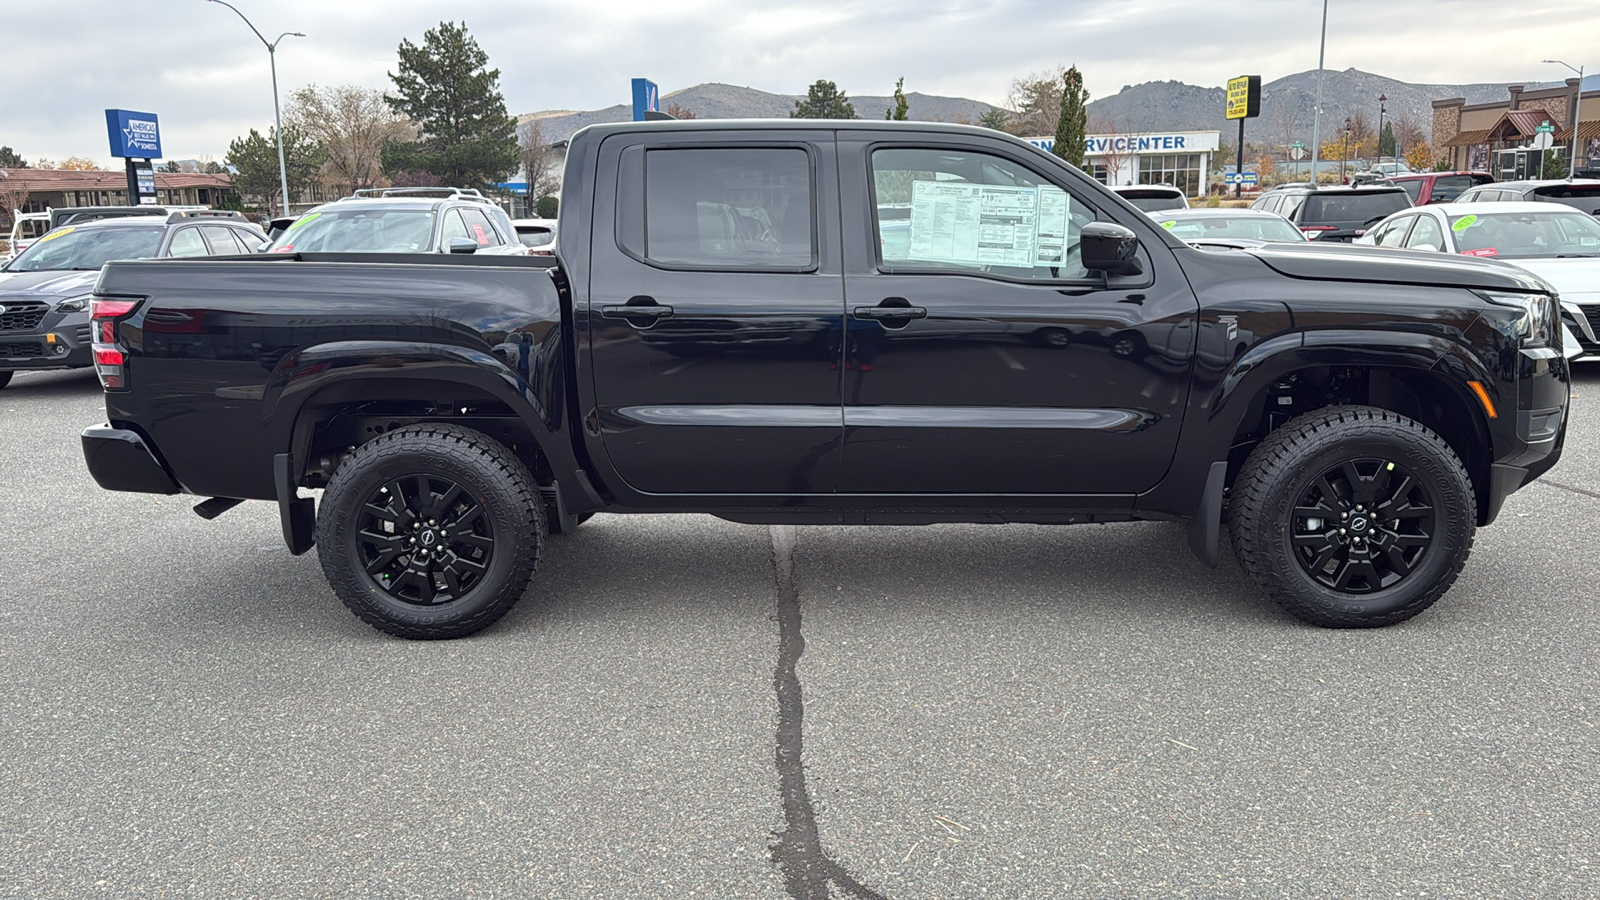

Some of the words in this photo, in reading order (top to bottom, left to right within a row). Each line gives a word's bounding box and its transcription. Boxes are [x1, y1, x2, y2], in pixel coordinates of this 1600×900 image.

[1084, 136, 1185, 152] RVICENTER
[986, 194, 994, 202] 19
[419, 454, 509, 533] YOKOHAMA
[1406, 446, 1458, 551] YOKOHAMA
